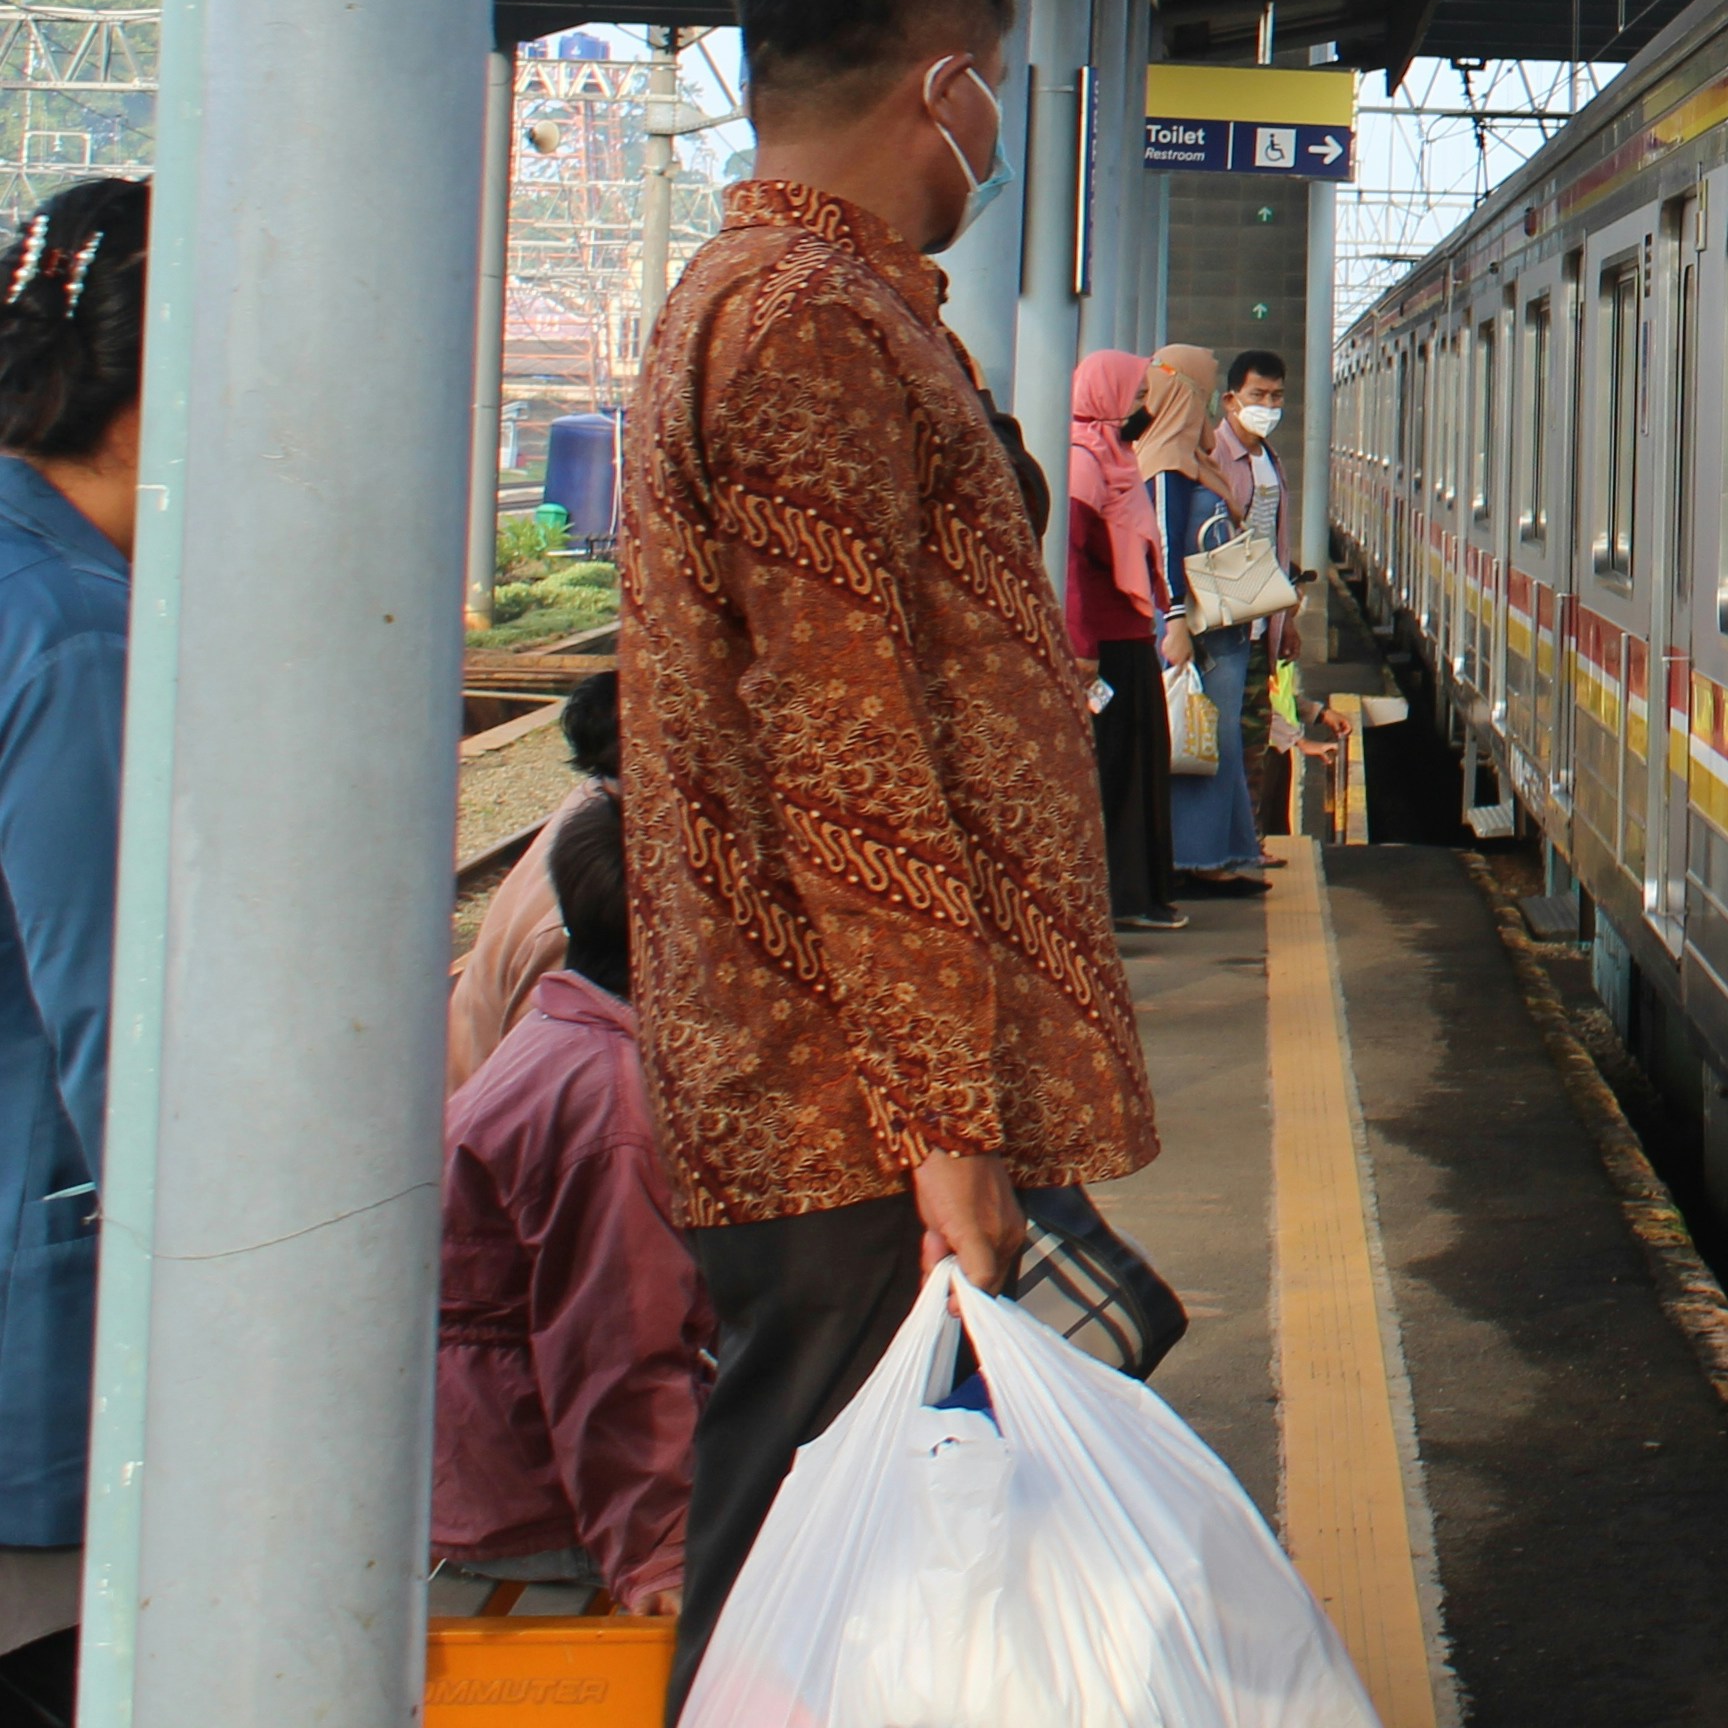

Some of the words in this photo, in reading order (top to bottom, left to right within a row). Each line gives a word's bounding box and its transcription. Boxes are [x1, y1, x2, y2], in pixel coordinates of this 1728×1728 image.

[1145, 124, 1206, 145] Toilet
[1144, 147, 1206, 161] Restroom
[426, 1678, 609, 1705] MMUTER
